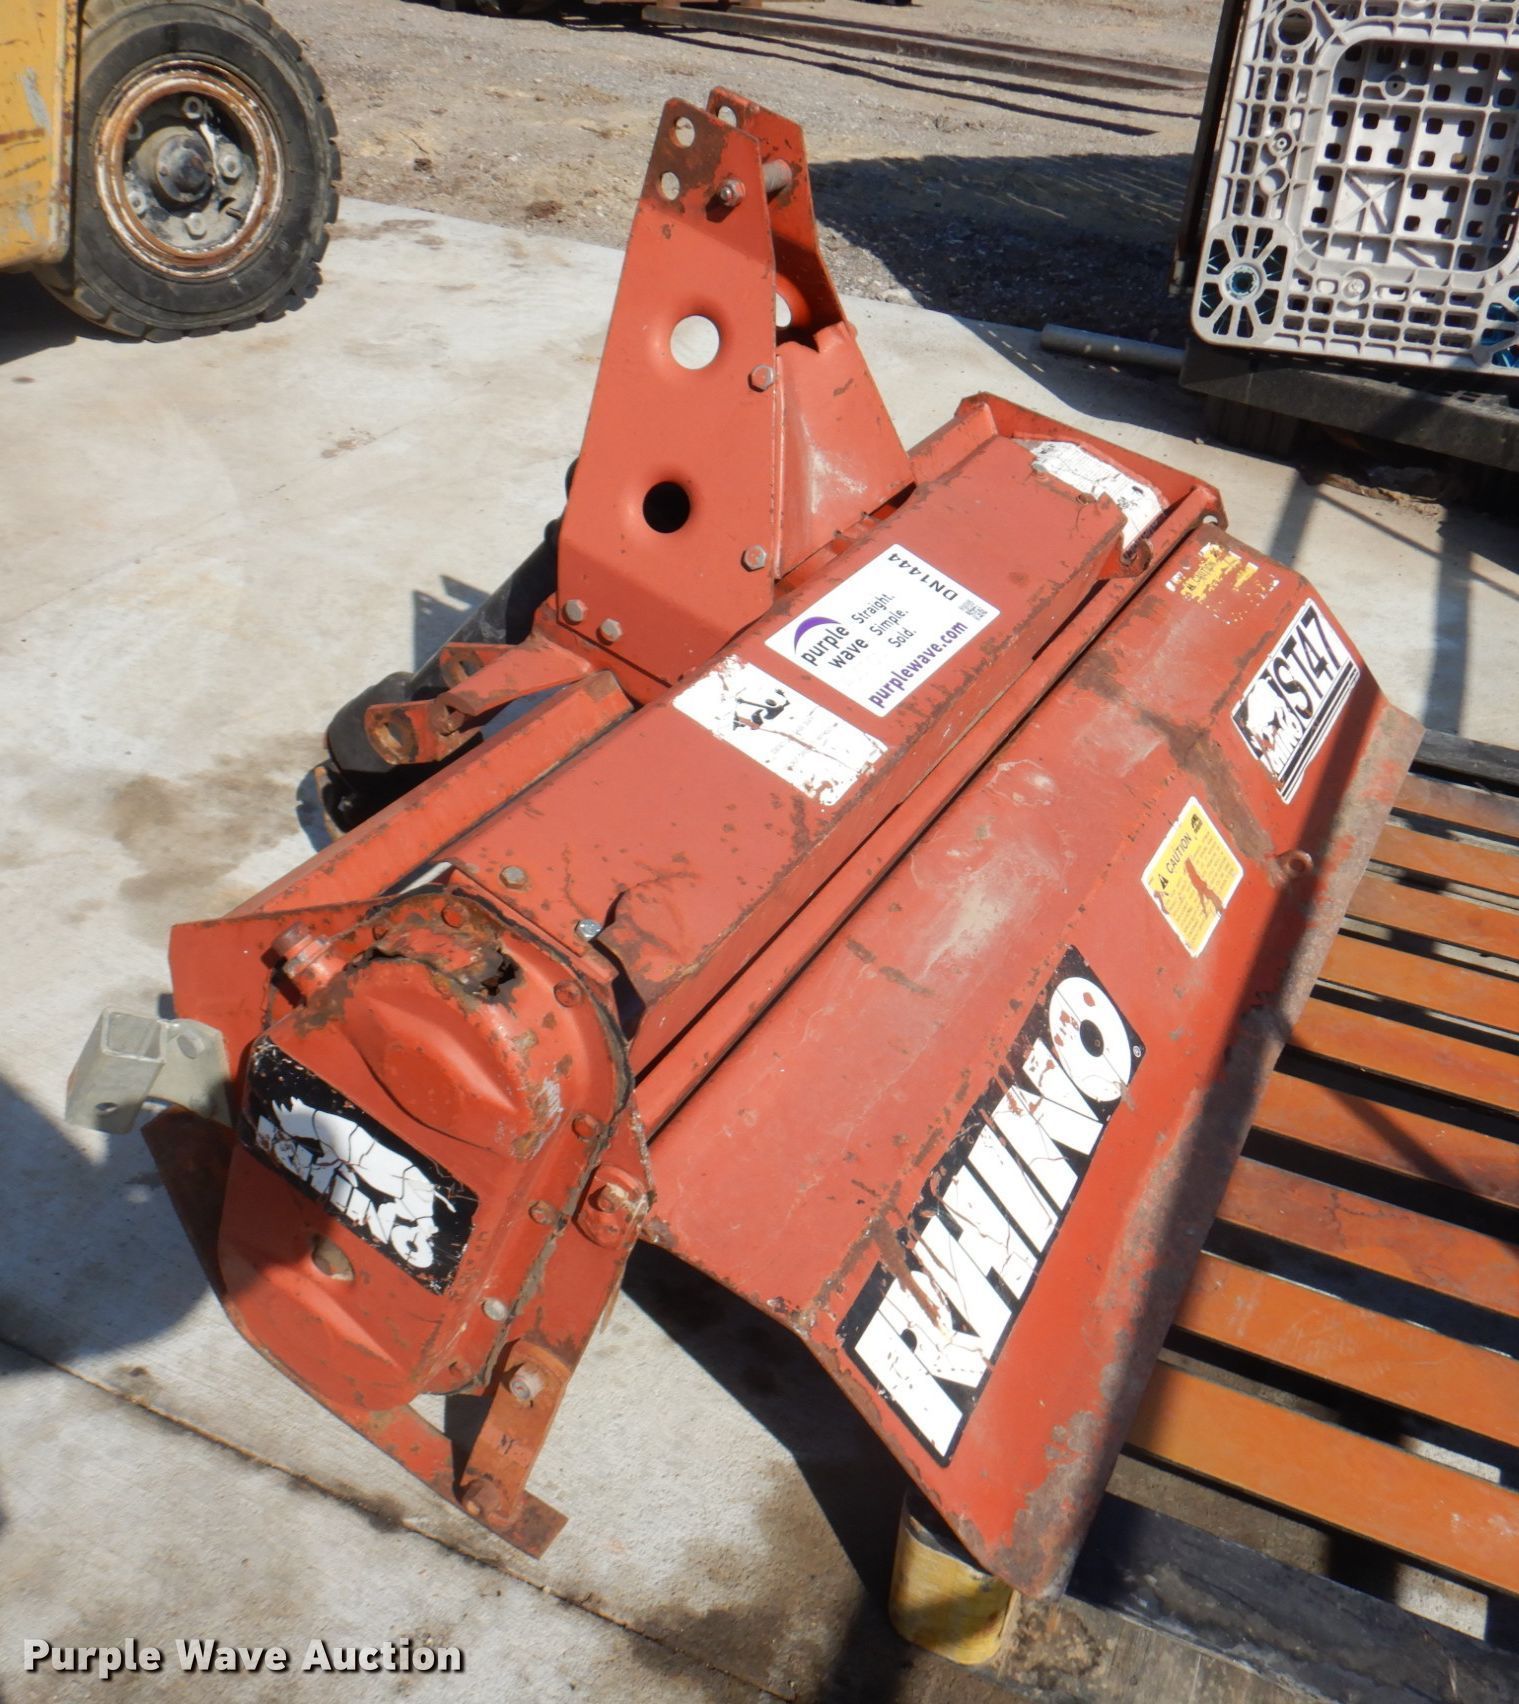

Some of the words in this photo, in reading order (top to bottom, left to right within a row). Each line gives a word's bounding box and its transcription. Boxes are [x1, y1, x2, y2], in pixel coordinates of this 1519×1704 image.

[888, 553, 958, 601] DN1444
[852, 593, 895, 624] Straight.
[870, 609, 909, 636] Simple.
[801, 624, 849, 666] purple
[828, 637, 869, 669] wave
[888, 630, 917, 648] Sold.
[868, 621, 967, 708] purplewave.com
[1273, 605, 1341, 720] ST47
[1165, 833, 1193, 875] CAUTION
[854, 976, 1133, 1458] RHINO
